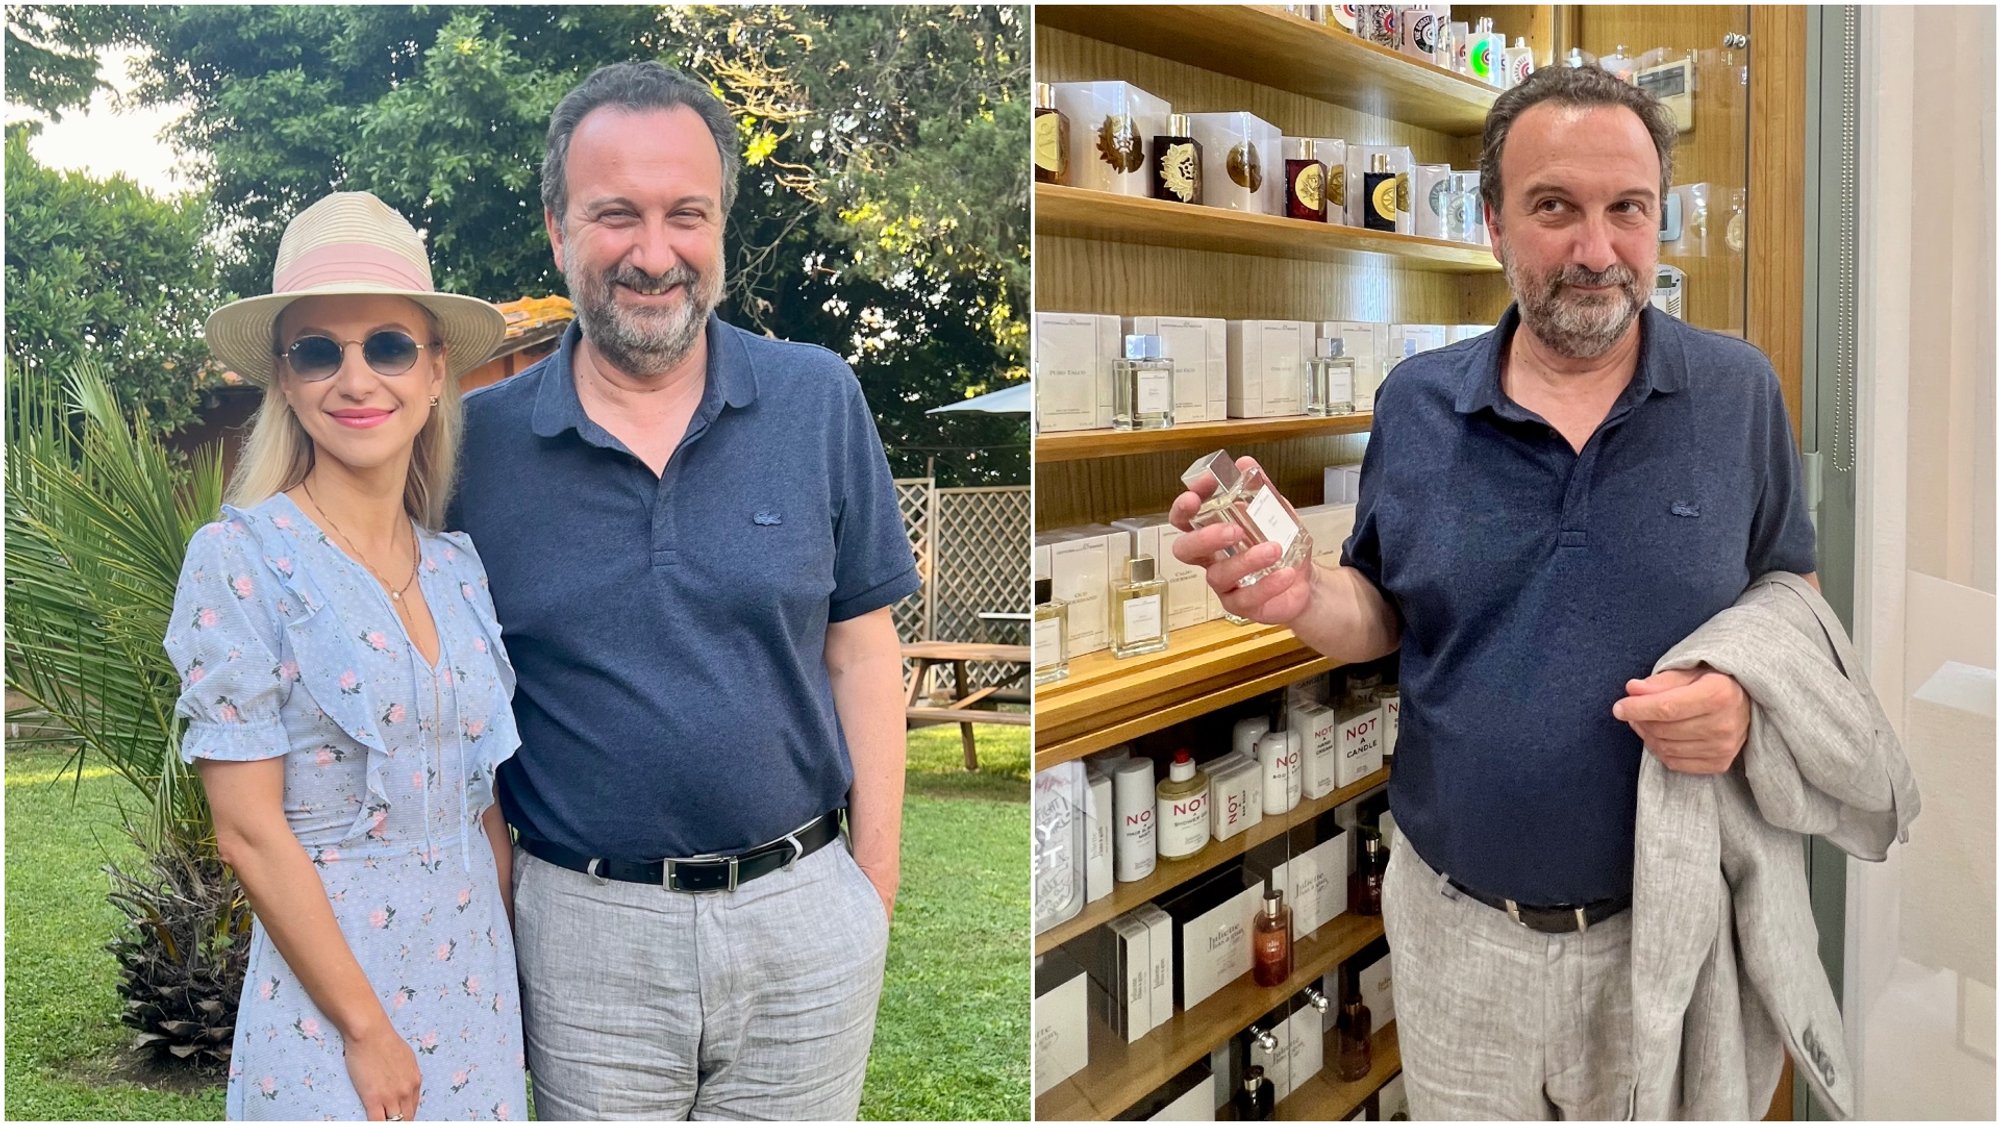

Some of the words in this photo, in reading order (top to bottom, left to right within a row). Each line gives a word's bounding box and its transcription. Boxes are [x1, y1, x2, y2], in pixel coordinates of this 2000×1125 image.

[1314, 724, 1333, 739] NOT
[1346, 717, 1377, 741] NOT
[1346, 739, 1378, 758] CANDLE
[1360, 737, 1366, 745] A
[1276, 748, 1302, 769] NO
[1173, 792, 1208, 817] NOT
[1228, 794, 1238, 826] NOT
[1174, 815, 1200, 827] SHOWER
[1208, 923, 1240, 952] Juliette
